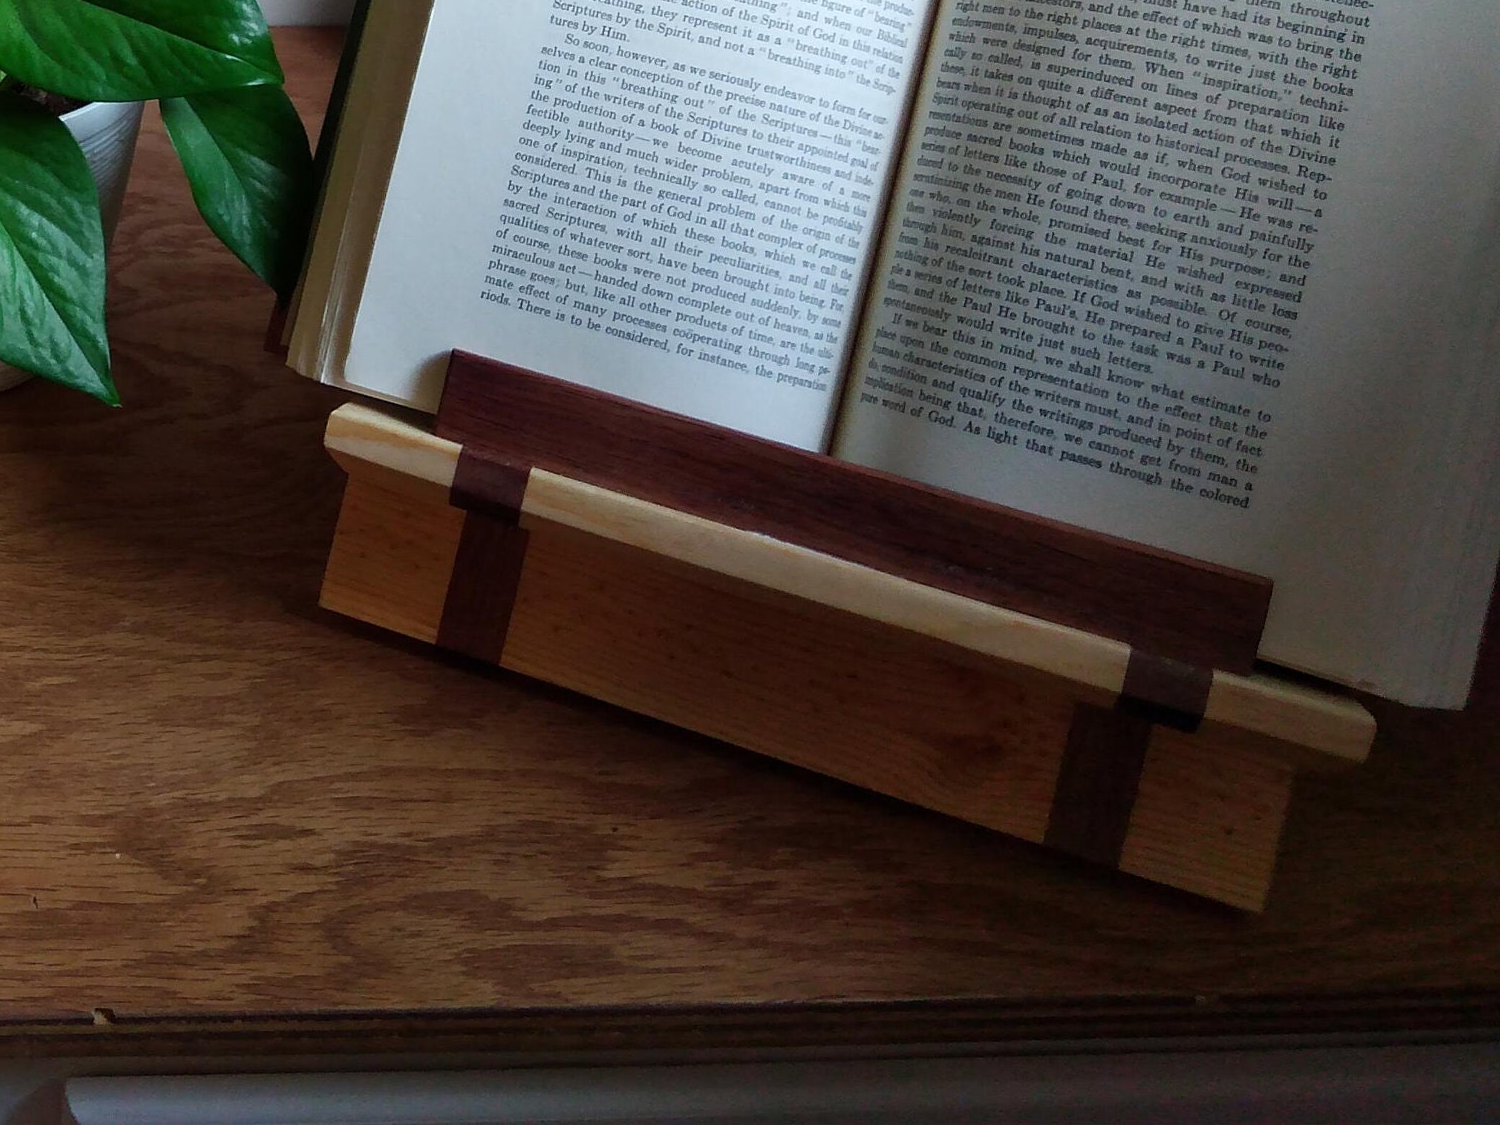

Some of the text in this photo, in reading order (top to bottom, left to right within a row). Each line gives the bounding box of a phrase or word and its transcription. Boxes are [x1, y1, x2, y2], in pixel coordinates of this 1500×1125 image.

[549, 14, 629, 42] tures by Him.
[721, 6, 736, 17] of
[738, 9, 758, 23] the
[759, 14, 794, 32] Spirit
[796, 25, 811, 36] of
[812, 27, 836, 43] God
[836, 34, 849, 47] in
[852, 39, 871, 53] this
[1087, 2, 1114, 15] and
[1117, 4, 1139, 19] the
[1142, 10, 1179, 26] effect
[1182, 17, 1199, 30] of
[1201, 21, 1241, 38] which
[1247, 31, 1273, 45] was
[1277, 35, 1292, 48] to
[1296, 37, 1334, 59] bring
[1338, 47, 1362, 62] the
[530, 89, 853, 181] the production of a book of Divine trustworthiness and
[969, 65, 1340, 149] it takes on quite a different aspect from that which it
[518, 136, 540, 149] one
[543, 141, 558, 153] of
[633, 164, 698, 190] technically
[702, 184, 717, 194] so
[763, 199, 802, 216] cannot
[805, 207, 819, 221] be
[992, 121, 1328, 201] are sometimes made as if, when God wished to
[932, 206, 1303, 303] violently forcing the material He wished expressed
[517, 297, 551, 317] There
[555, 308, 566, 322] is
[570, 314, 582, 326] to
[586, 317, 601, 332] be
[605, 326, 670, 353] considered,
[675, 342, 695, 357] for
[755, 364, 773, 379] the
[956, 315, 994, 332] would
[999, 326, 1034, 342] write
[1037, 333, 1065, 351] just
[1070, 345, 1101, 360] such
[881, 398, 1249, 509] word of God. As light that passes through the colored
